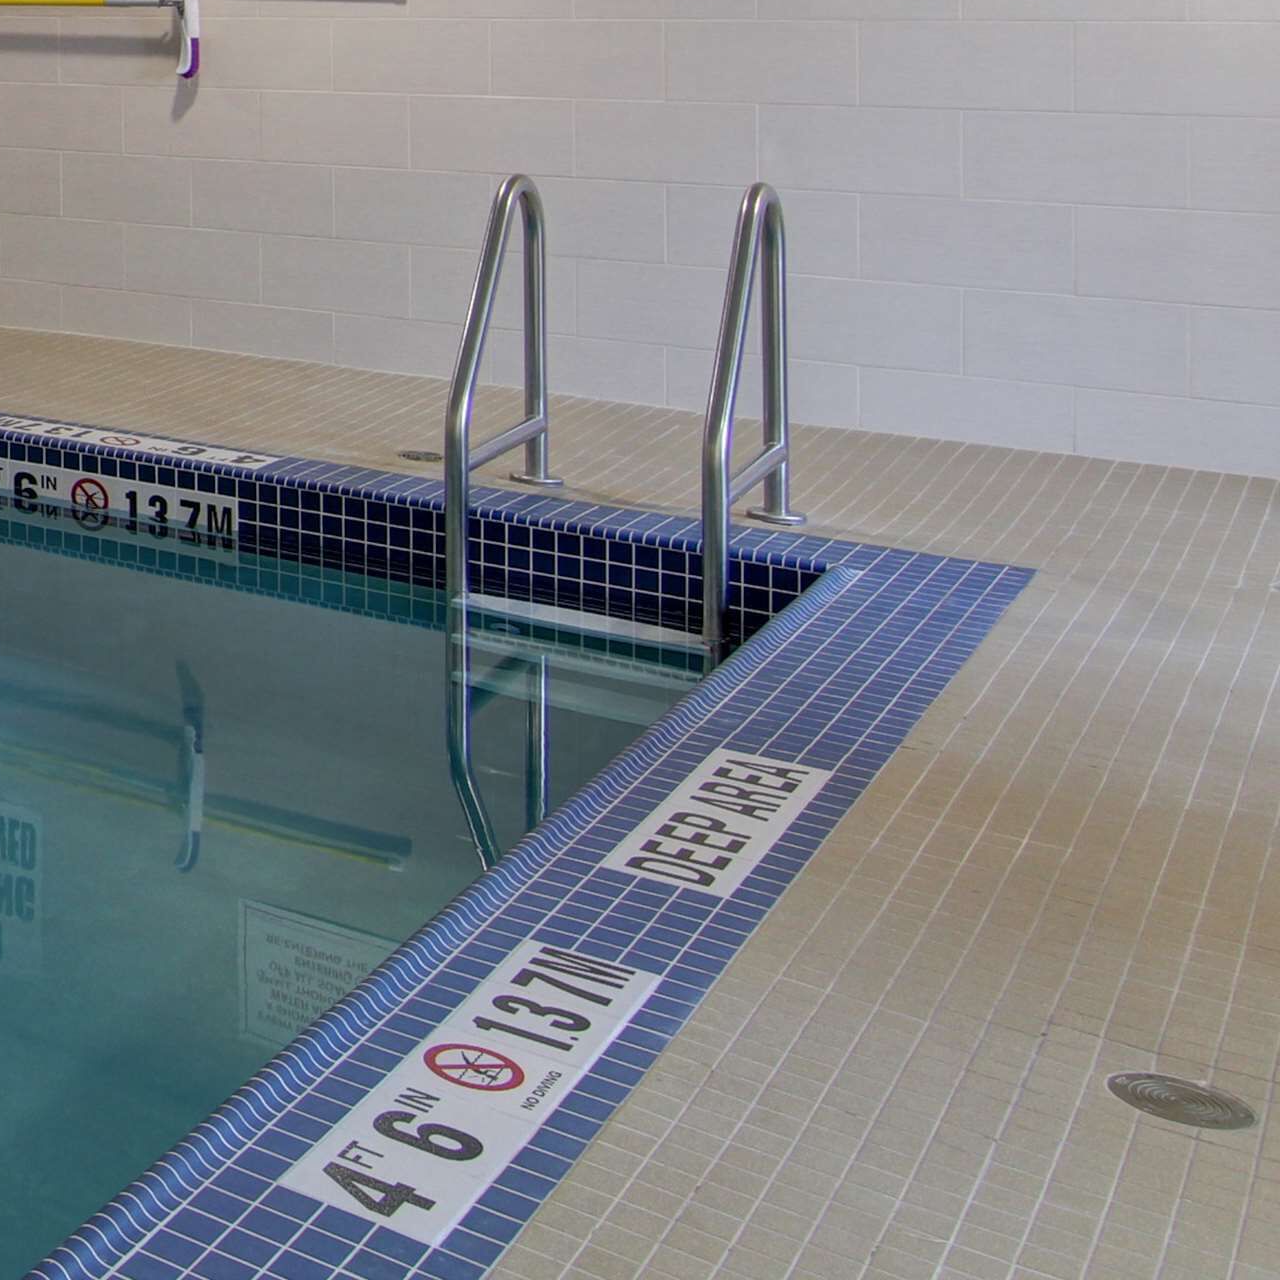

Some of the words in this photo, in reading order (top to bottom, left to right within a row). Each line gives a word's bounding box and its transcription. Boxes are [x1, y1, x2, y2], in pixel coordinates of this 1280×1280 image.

[624, 811, 751, 887] DEEP
[690, 759, 810, 821] AREA
[520, 1096, 540, 1111] NO
[531, 1070, 562, 1097] DIVING
